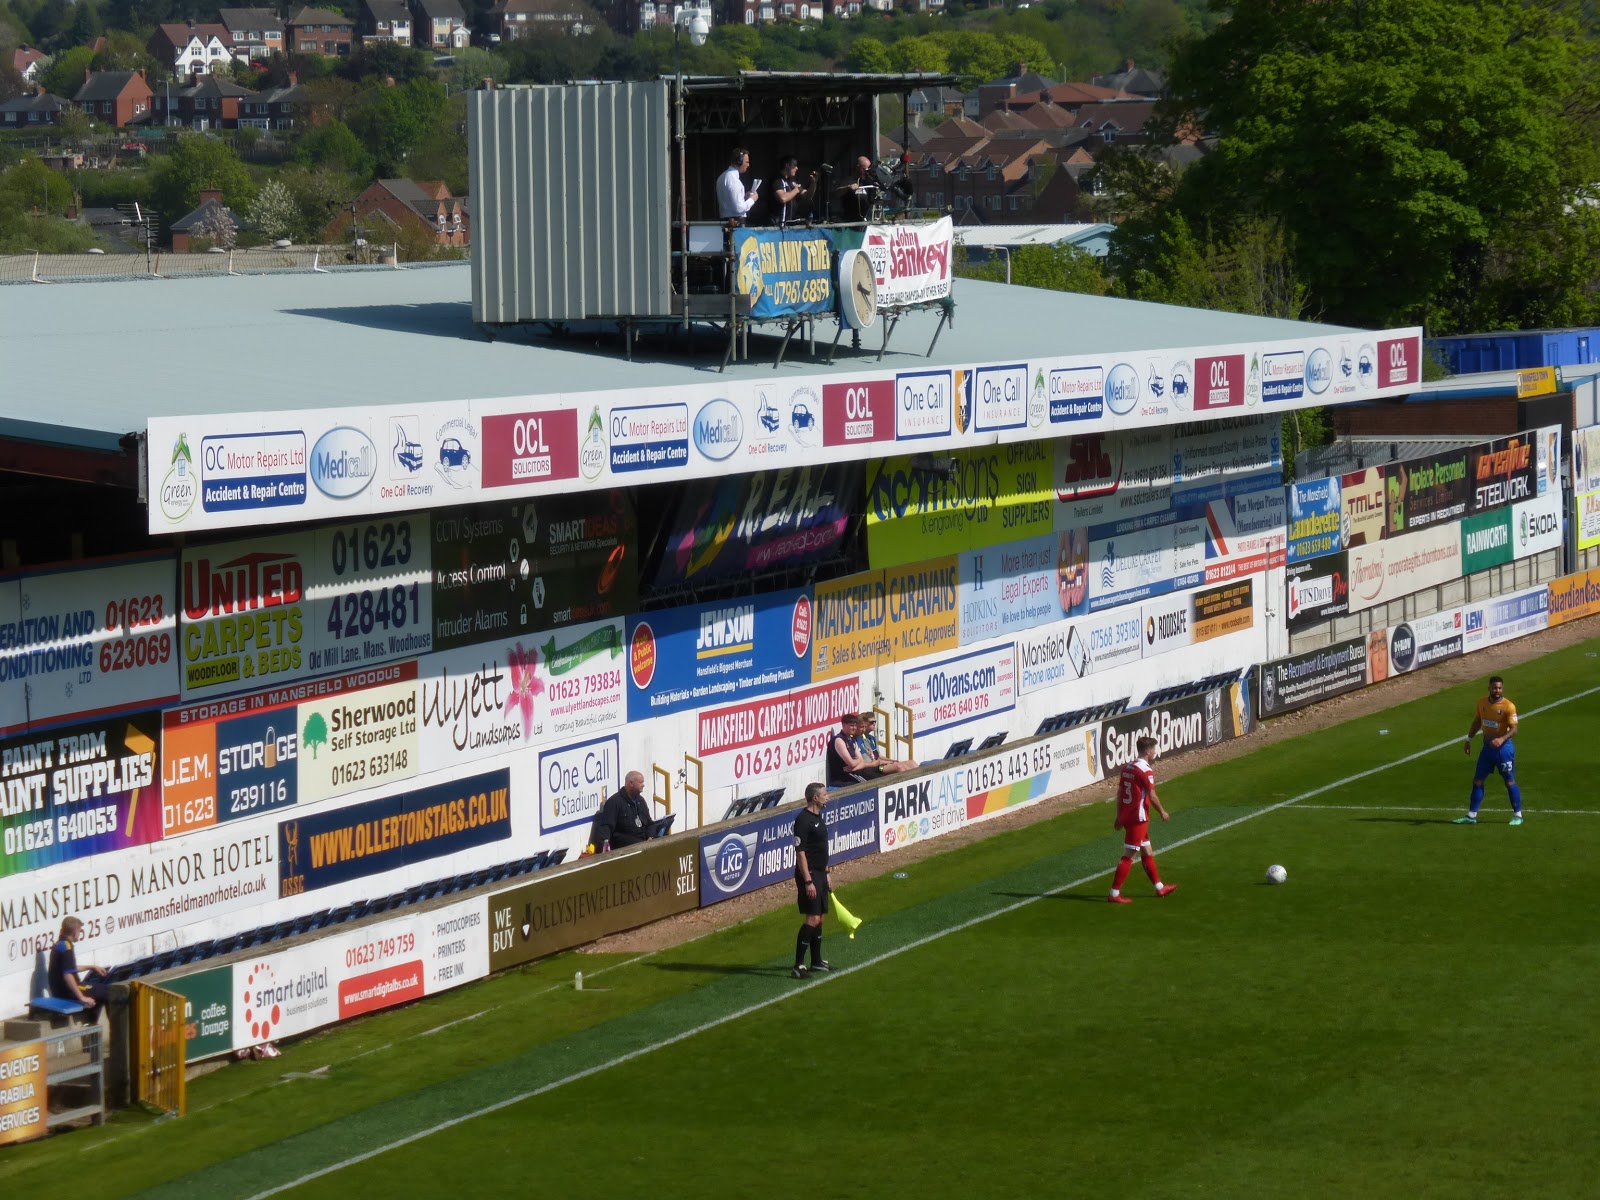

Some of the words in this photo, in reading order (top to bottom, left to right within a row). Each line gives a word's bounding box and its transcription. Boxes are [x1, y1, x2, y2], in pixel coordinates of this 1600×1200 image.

[896, 228, 914, 247] John
[870, 248, 886, 258] 01623
[890, 232, 948, 280] Sankey
[904, 386, 924, 411] One
[927, 384, 944, 409] Call
[904, 416, 944, 426] INSURANCE
[513, 418, 549, 455] OCL
[206, 446, 224, 470] OC
[227, 453, 254, 470] Motor
[257, 449, 287, 471] Repairs
[290, 448, 303, 465] Ltd
[318, 446, 369, 480] Medicall
[1007, 441, 1046, 464] OFFICIAL
[514, 460, 549, 474] SOLICITORS
[1435, 455, 1466, 485] Personnel
[206, 487, 241, 502] Accident
[243, 485, 249, 499] &
[251, 485, 276, 500] Repair
[279, 482, 304, 496] Centre
[381, 487, 393, 498] One
[394, 486, 406, 497] Call
[407, 484, 432, 496] Recovery
[1017, 472, 1036, 493] SIGN
[1308, 485, 1328, 502] Mansfield
[1476, 475, 1528, 509] STEELWORK
[1003, 501, 1049, 528] SUPPLIERS
[1074, 507, 1088, 517] Trailers
[1089, 505, 1103, 516] Limited
[1348, 491, 1382, 515] TMLC
[1410, 513, 1429, 526] EXPERTS
[1431, 512, 1436, 521] IN
[1437, 503, 1465, 519] RECRUITMENT
[436, 521, 460, 543] CCTV
[464, 517, 503, 543] Systems
[1289, 511, 1339, 540] Launderette
[1530, 512, 1558, 537] ŠKODA
[1467, 524, 1507, 554] RAINWORTH
[1002, 553, 1020, 574] More
[1021, 550, 1038, 570] than
[1039, 545, 1051, 570] just
[437, 571, 467, 590] Access
[471, 563, 506, 584] Control
[1002, 578, 1020, 604] Legal
[1023, 574, 1048, 600] Experts
[328, 581, 419, 640] 428481
[816, 581, 885, 640] MANSFIELD
[890, 566, 956, 623] CARAVANS
[963, 597, 997, 624] HOPKINS
[1002, 611, 1009, 624] We
[1010, 609, 1020, 621] love
[1021, 607, 1025, 620] to
[1026, 605, 1036, 619] help
[1037, 604, 1051, 618] people
[184, 606, 303, 661] CARPETS
[437, 613, 472, 638] Intruder
[475, 610, 508, 631] Alarms
[697, 605, 754, 649] JEWSON
[1159, 609, 1187, 640] ROODSAFE
[1466, 610, 1483, 630] LEW
[832, 643, 849, 665] Sales
[851, 644, 857, 660] &
[858, 637, 891, 660] Servicing
[902, 629, 922, 648] N.C.C.
[924, 619, 956, 644] Approved
[1091, 628, 1113, 650] 07568
[1116, 618, 1140, 643] 393180
[100, 633, 170, 673] 623069
[243, 655, 254, 678] &
[258, 645, 301, 676] BEDS
[310, 652, 321, 670] Old
[324, 649, 338, 665] Mill
[341, 646, 361, 663] Lane,
[364, 640, 386, 658] Mans.
[389, 634, 430, 653] Woodhouse
[634, 651, 638, 662] &
[638, 644, 651, 658] Public
[1022, 632, 1064, 668] Mansfield
[1278, 665, 1288, 682] The
[1289, 658, 1316, 679] Recruitment
[1317, 655, 1320, 670] &
[1322, 648, 1349, 671] Employment
[1350, 645, 1365, 660] Bureau
[79, 672, 91, 684] LTD
[188, 662, 237, 682] WOODFLOOR
[634, 656, 653, 674] welcome
[697, 663, 719, 676] Mansfield's
[719, 661, 734, 674] Biggest
[735, 658, 753, 670] Merchant
[1022, 669, 1044, 688] iPhone
[1045, 662, 1065, 683] repairs
[181, 700, 246, 723] STORAGE
[252, 694, 263, 708] IN
[269, 680, 341, 705] MANSFIELD
[347, 667, 400, 688] WOODUS
[550, 678, 580, 702] 01623
[584, 669, 621, 694] 793834
[651, 693, 669, 706] Building
[670, 690, 689, 704] Materials
[693, 686, 708, 696] Garden
[709, 681, 735, 696] Landscaping
[739, 675, 753, 687] Timber
[762, 672, 777, 686] Roofing
[778, 668, 794, 681] Products
[926, 666, 995, 703] 100vans.com
[332, 691, 416, 732] Sherwood
[550, 694, 620, 716] www.ulyettlandscapes.com
[701, 710, 754, 750] MANSFIELD
[758, 702, 795, 738] CARPETS
[797, 700, 802, 728] &
[804, 693, 830, 721] WOOD
[831, 683, 859, 718] FLOORS
[934, 704, 957, 722] 01623
[959, 700, 973, 717] 640
[974, 694, 989, 713] 976
[332, 735, 352, 751] Self
[356, 726, 397, 750] Storage
[400, 718, 416, 735] Ltd
[470, 723, 520, 750] Landscapes
[534, 725, 543, 735] Ltd
[2, 741, 54, 777] PAINT
[59, 731, 107, 765] FROM
[1502, 761, 1512, 771] 23
[332, 760, 366, 786] 01623
[370, 750, 408, 776] 633148
[967, 761, 1004, 794] 01623
[1009, 752, 1028, 778] 443
[1033, 744, 1050, 772] 655
[164, 796, 214, 829] 01623
[231, 779, 286, 813] 239116
[561, 793, 599, 817] Stadium
[1123, 782, 1132, 804] 3
[5, 819, 54, 855] 01623
[58, 805, 117, 843] 640053
[310, 788, 508, 868] WWW.OLLERTONSTAGS.CO.UK
[932, 810, 944, 830] self
[946, 805, 965, 826] drive
[721, 851, 743, 875] LKC
[724, 872, 740, 881] MOTORS
[0, 874, 120, 932] MANSFIELD
[131, 852, 206, 898] MANOR
[213, 835, 273, 877] HOTEL
[283, 874, 304, 896] OSSC
[676, 874, 696, 896] SELL
[21, 930, 57, 957] 01623
[88, 921, 101, 938] 25
[118, 874, 266, 929] www.mansfieldmanorhotel.co.uk
[437, 912, 480, 936] PHOTOCOPIERS
[495, 907, 512, 930] WE
[346, 943, 374, 968] 01623
[378, 938, 395, 958] 749
[397, 933, 414, 953] 759
[438, 939, 466, 958] PRINTERS
[493, 928, 515, 952] BUY
[439, 966, 453, 982] FREE
[453, 962, 464, 976] INK
[256, 980, 294, 1008] smart
[296, 967, 328, 1003] digital
[344, 973, 418, 1005] www.smartdigitalbs.co.uk
[201, 1003, 226, 1021] coffee
[286, 1003, 307, 1017] business
[308, 996, 328, 1013] solutions
[201, 1019, 229, 1036] lounge
[0, 1054, 40, 1080] EVENTS
